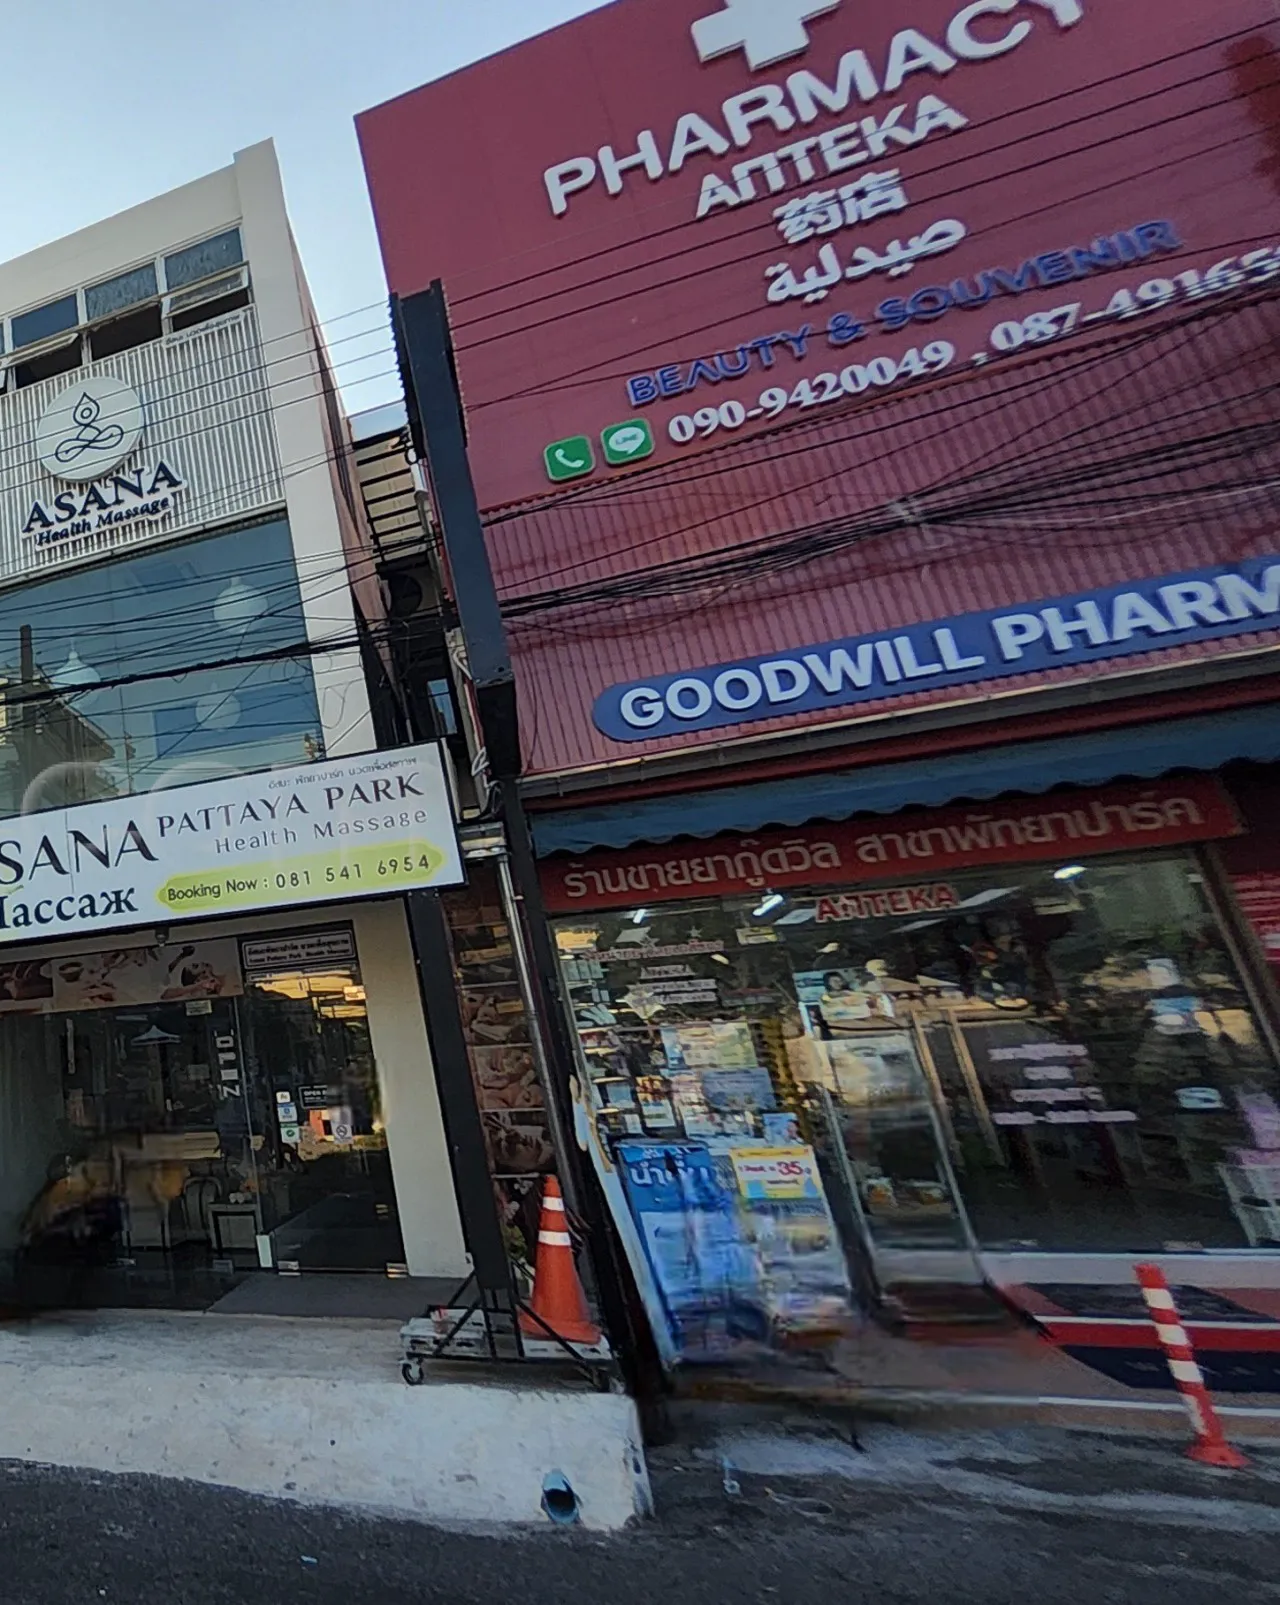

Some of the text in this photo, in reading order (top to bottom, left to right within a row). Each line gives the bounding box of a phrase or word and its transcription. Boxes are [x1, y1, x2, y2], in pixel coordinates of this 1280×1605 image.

[696, 95, 970, 218] АПТЕКА
[772, 168, 908, 244] 药店
[764, 219, 967, 303] صيدلية
[627, 219, 1184, 406] BEAUTY & SOUVENIR
[668, 340, 956, 444] 090-9420049
[22, 460, 184, 533] ASANA
[36, 498, 170, 547] Health Massage
[620, 626, 985, 728] GOODWILL
[156, 793, 310, 837] PATTAYA
[323, 772, 424, 811] PARK
[215, 809, 428, 854] Health Massage
[167, 882, 221, 902] Booking
[226, 877, 258, 894] Now
[275, 870, 312, 889] 081
[324, 863, 363, 883] 541
[377, 854, 430, 876] 6954
